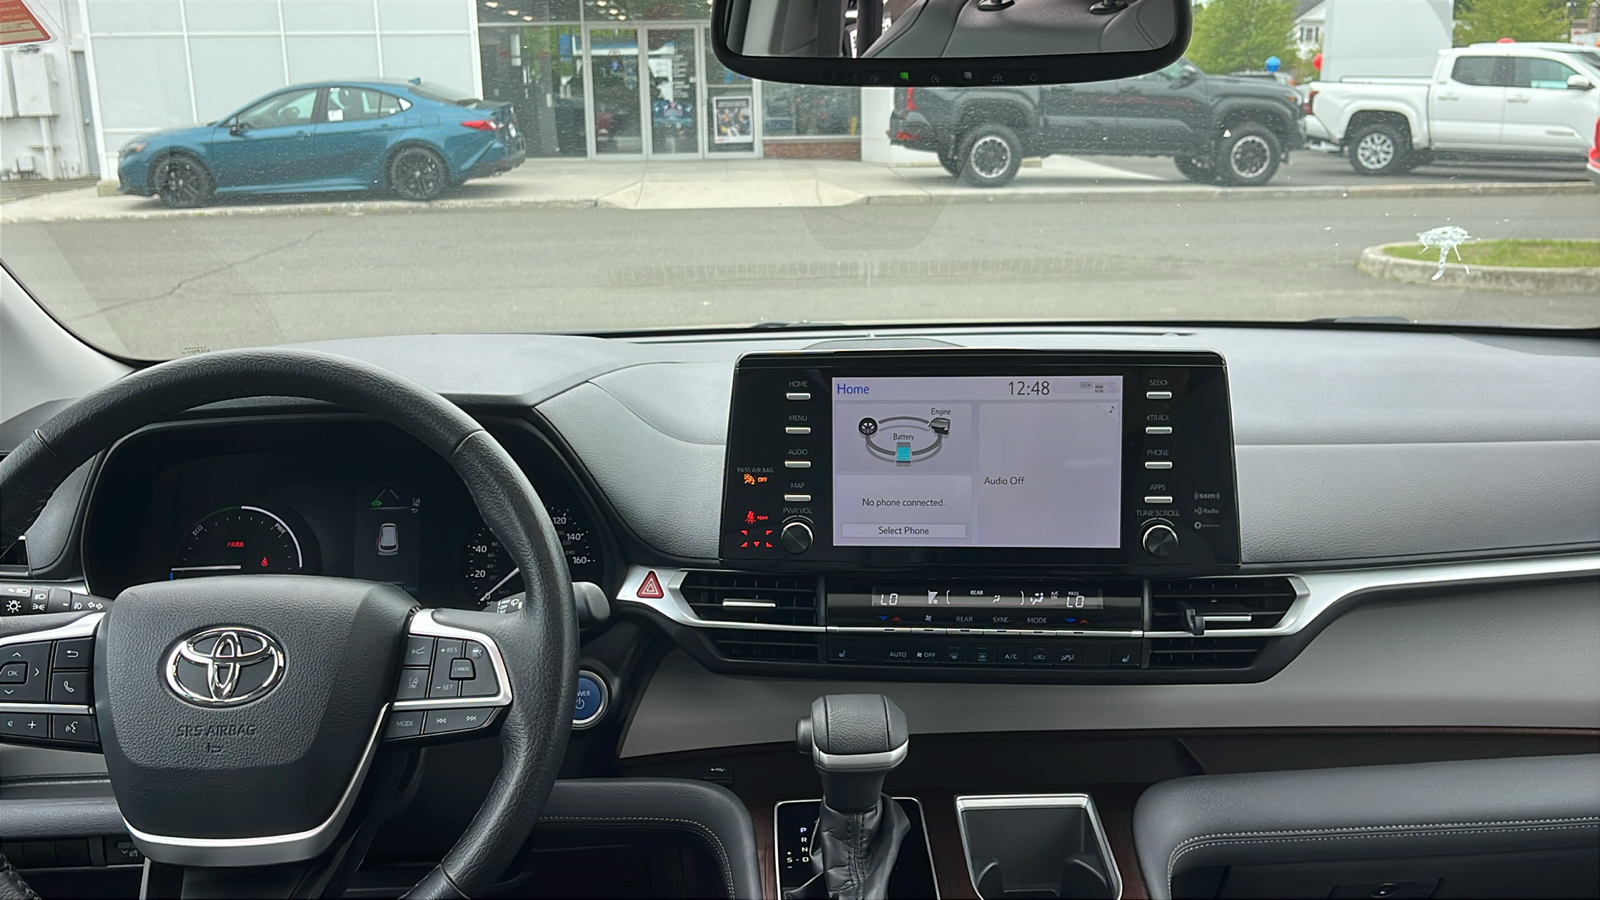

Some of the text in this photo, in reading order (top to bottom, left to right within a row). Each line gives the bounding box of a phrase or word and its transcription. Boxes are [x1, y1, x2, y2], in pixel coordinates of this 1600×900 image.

[788, 380, 809, 388] HOME
[1008, 380, 1050, 396] 12:48
[837, 383, 870, 395] Home
[931, 408, 951, 417] Engine
[788, 414, 808, 422] MENU
[1150, 413, 1170, 421] TRACK
[893, 433, 914, 442] Battery
[788, 448, 808, 456] AUDIO
[1147, 449, 1170, 457] PHONE
[984, 476, 1025, 485] Audio Off
[862, 498, 946, 509] No phone connected.
[1136, 509, 1179, 517] TUNE SCROLL
[552, 516, 567, 525] 120
[878, 526, 930, 535] Select Phone
[566, 533, 582, 541] 140
[475, 545, 488, 553] 40
[572, 556, 587, 564] 160
[474, 570, 486, 578] 20
[177, 724, 256, 737] SRS AIRBAG
